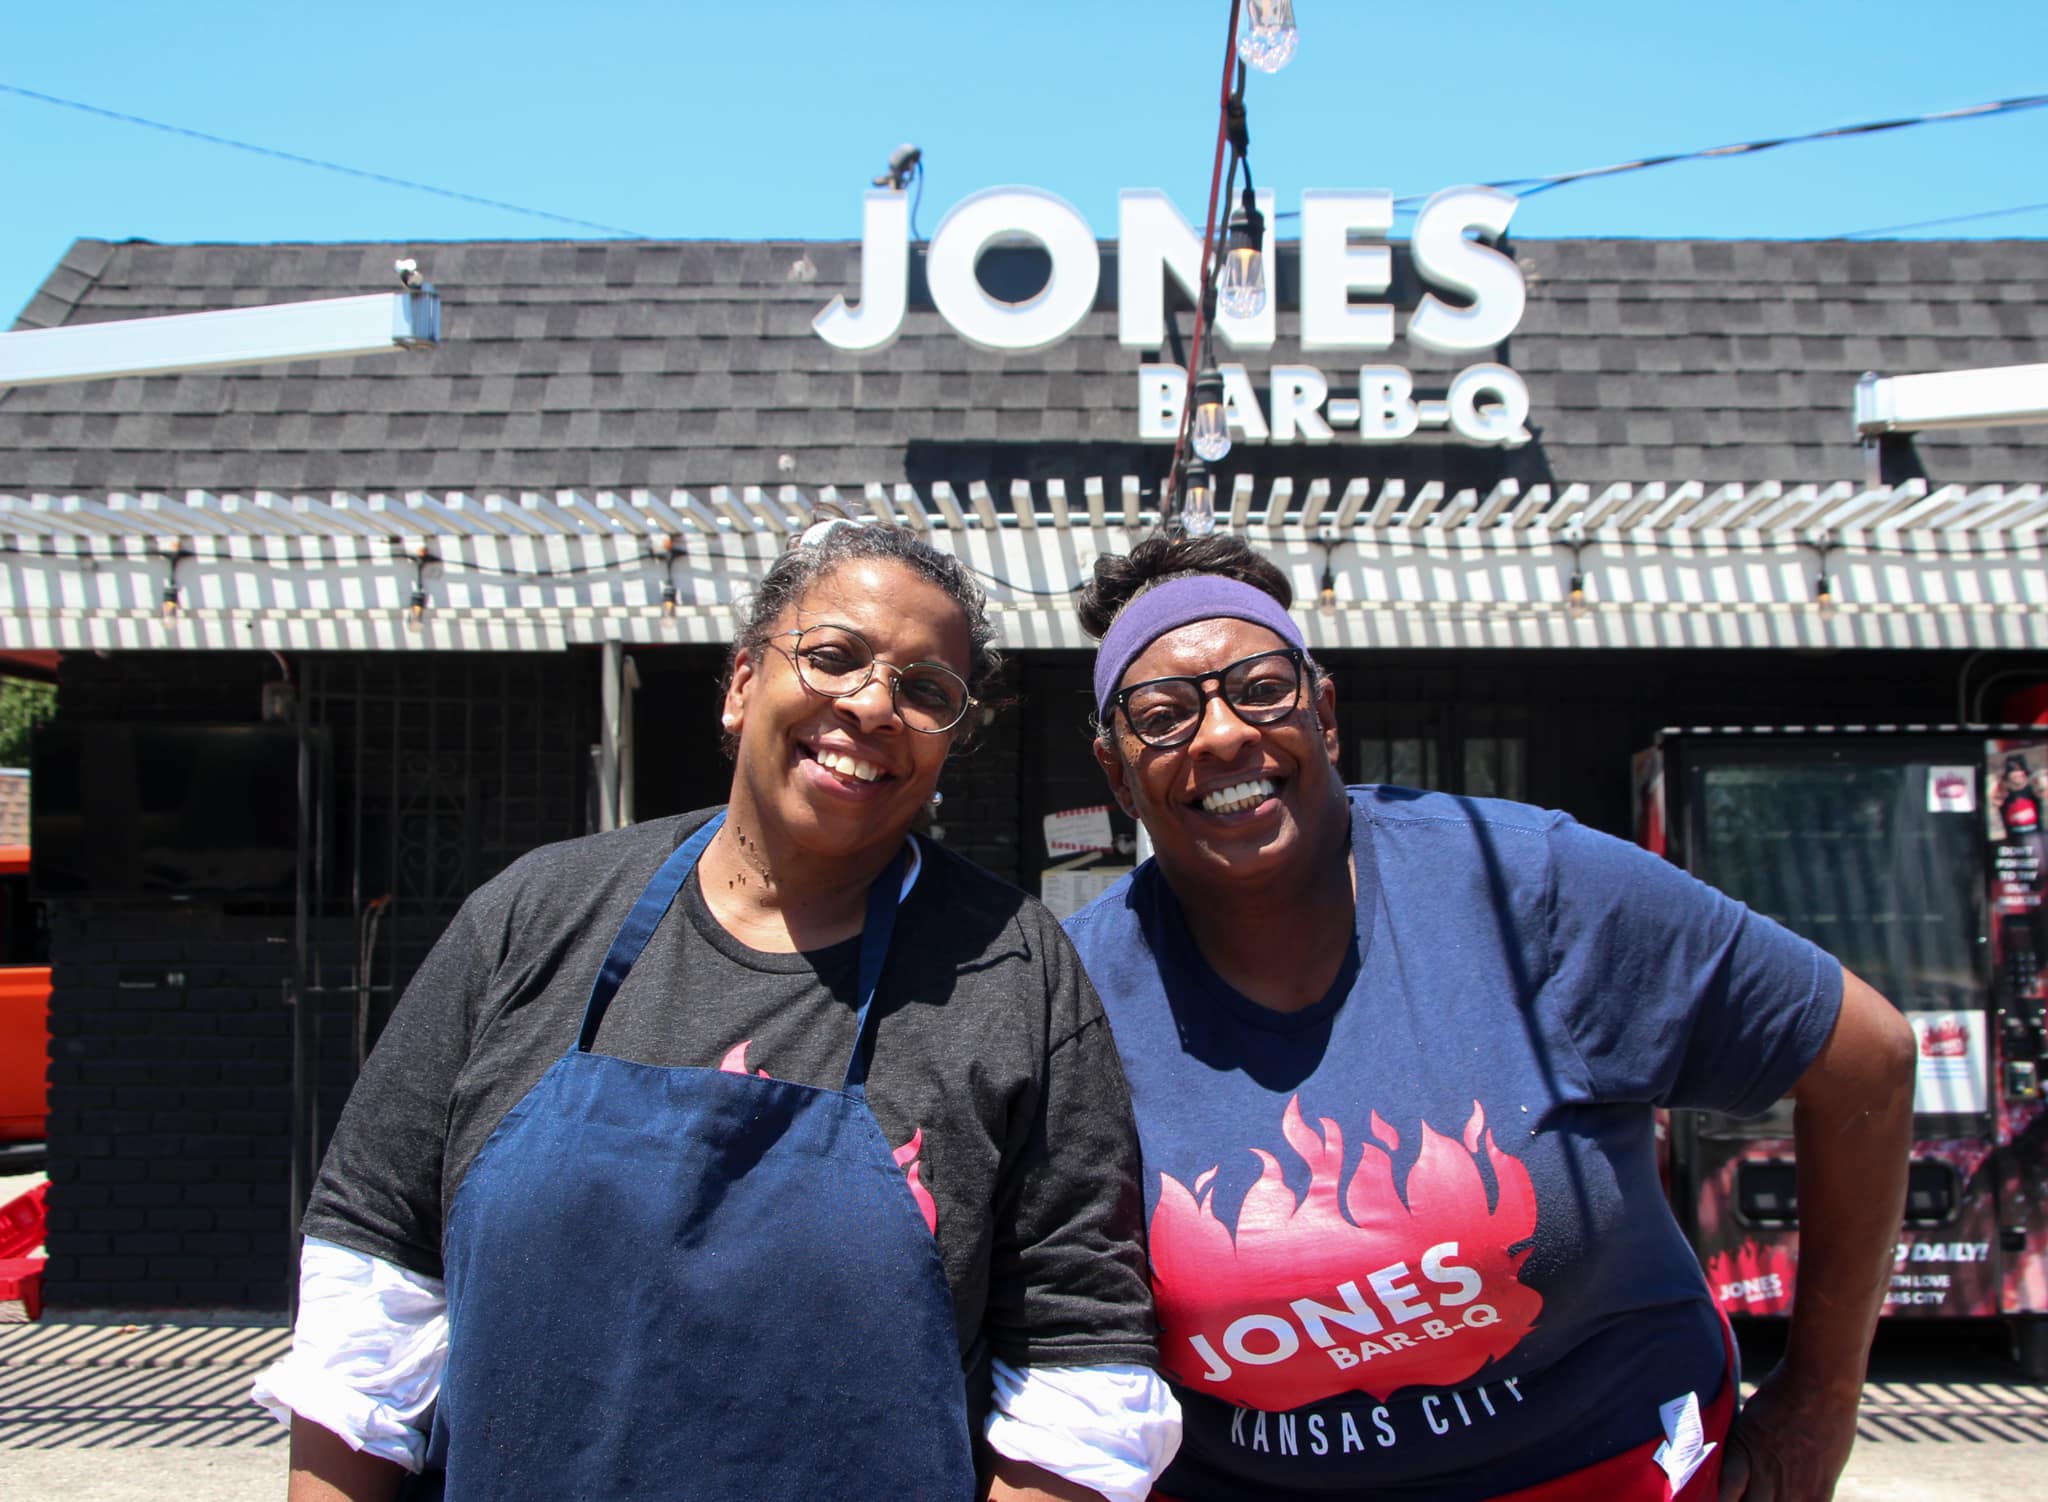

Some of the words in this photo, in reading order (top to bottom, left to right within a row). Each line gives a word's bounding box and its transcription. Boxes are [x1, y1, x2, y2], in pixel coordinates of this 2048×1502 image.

[813, 185, 1527, 351] JONES
[1138, 363, 1531, 446] BAR-B-Q
[1911, 1242, 1989, 1262] DAILY!
[1719, 1273, 1782, 1301] JONES
[1912, 1291, 1946, 1304] CITY
[1914, 1274, 1951, 1288] LOVE
[1188, 1241, 1483, 1383] JONES
[1326, 1303, 1502, 1371] BAR-B-Q
[1231, 1405, 1397, 1457] KANSAS
